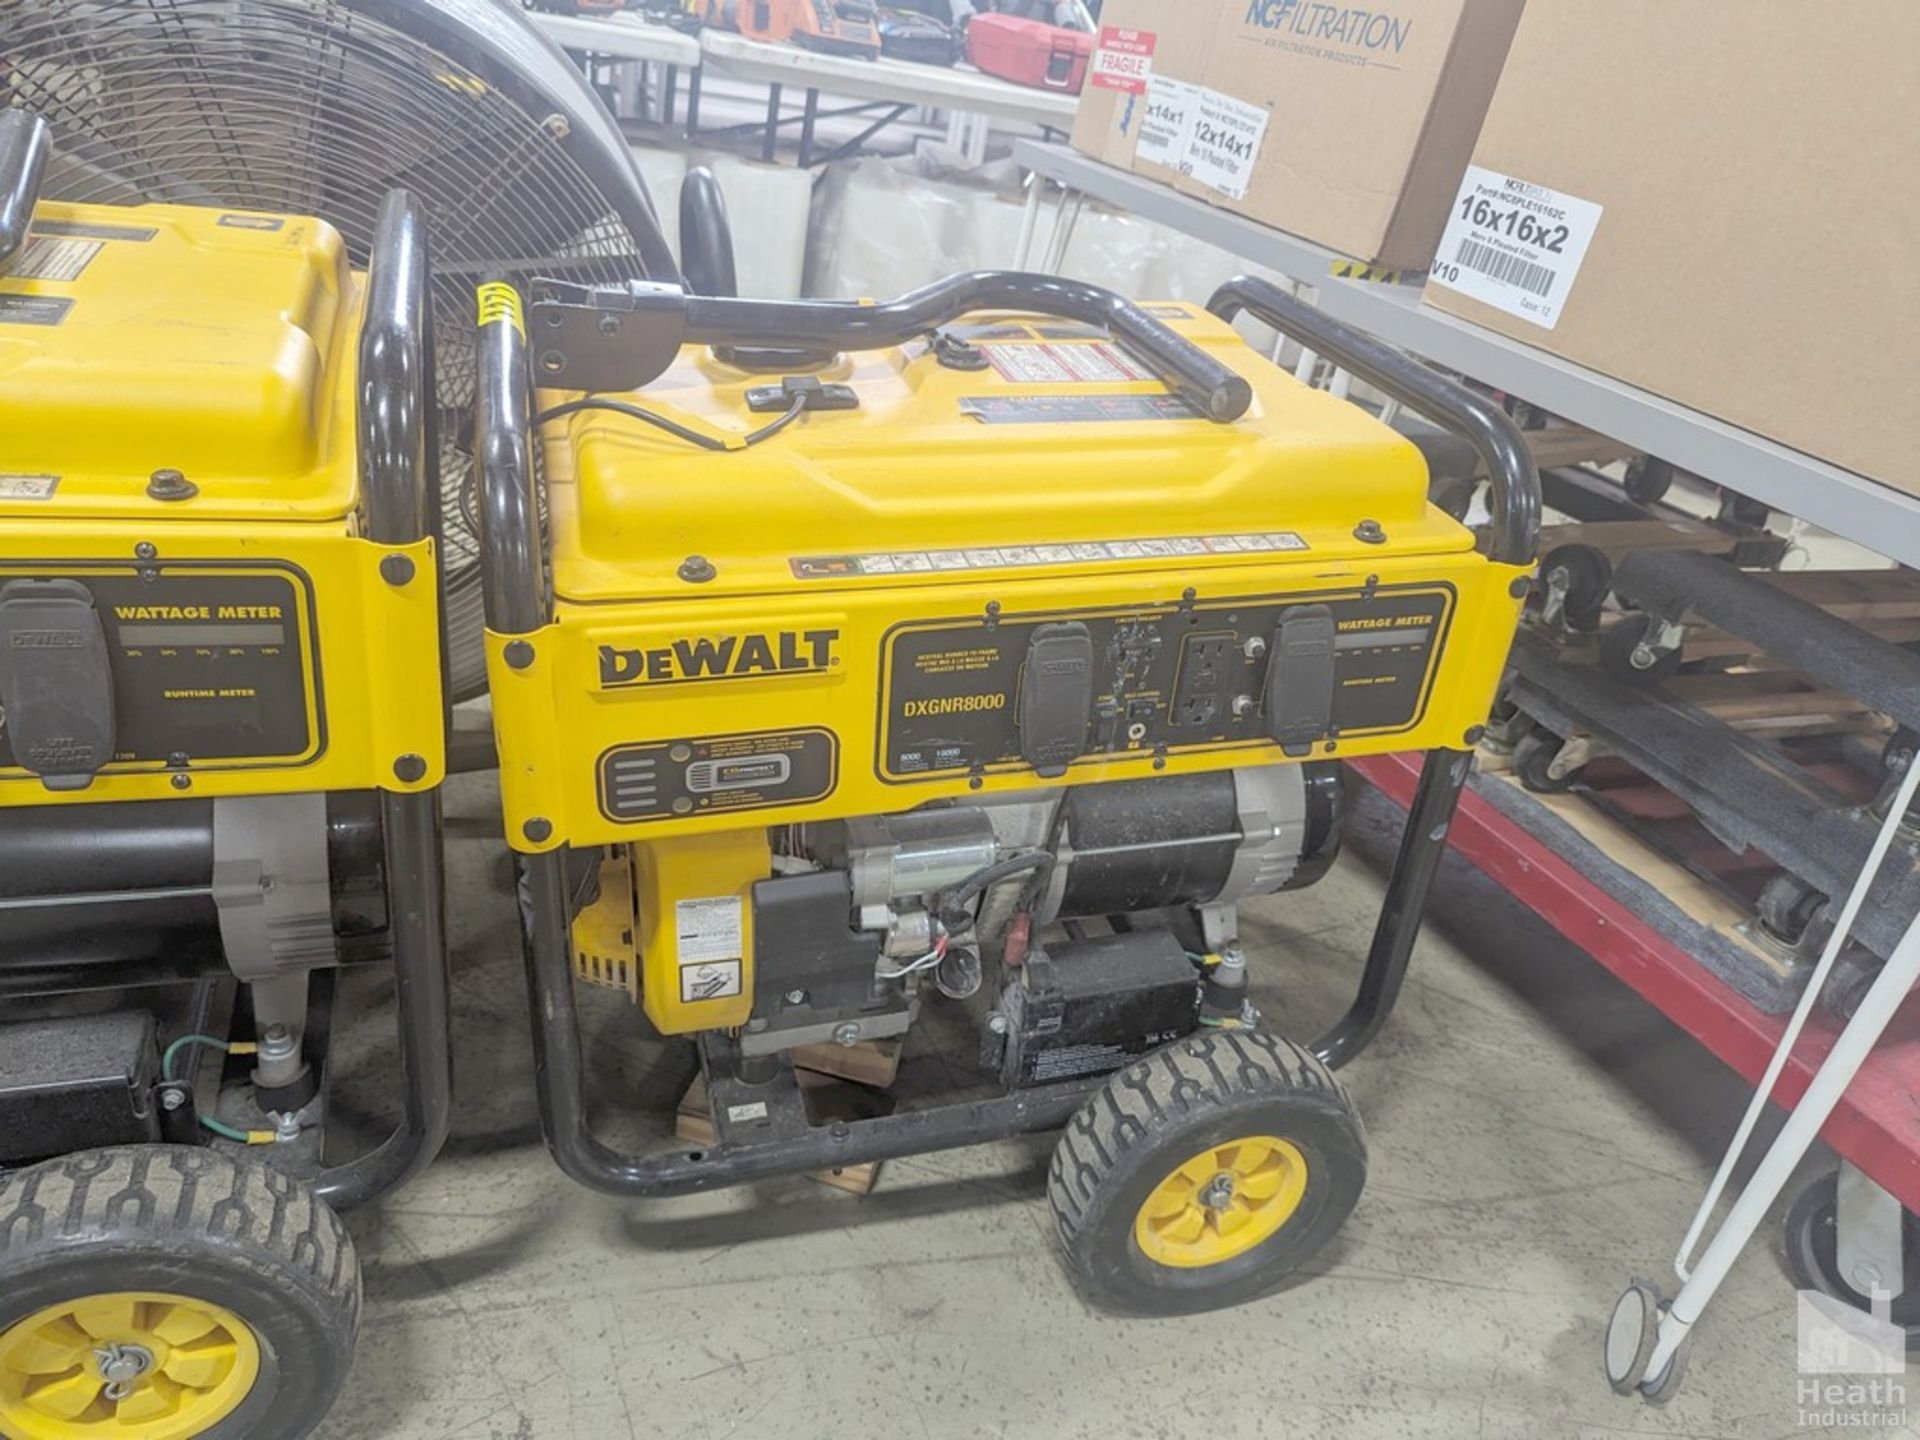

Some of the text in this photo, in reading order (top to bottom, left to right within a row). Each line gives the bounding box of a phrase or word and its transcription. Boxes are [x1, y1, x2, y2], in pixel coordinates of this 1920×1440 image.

[1101, 53, 1144, 76] FRAGILE
[1194, 120, 1253, 161] 12x14x1
[1461, 194, 1569, 254] 16x16x2
[115, 606, 282, 619] WATTAGE METER
[1338, 614, 1433, 631] WATTAGE METER
[164, 689, 256, 699] RUNTIME METER
[904, 693, 1006, 718] DXGNR8000
